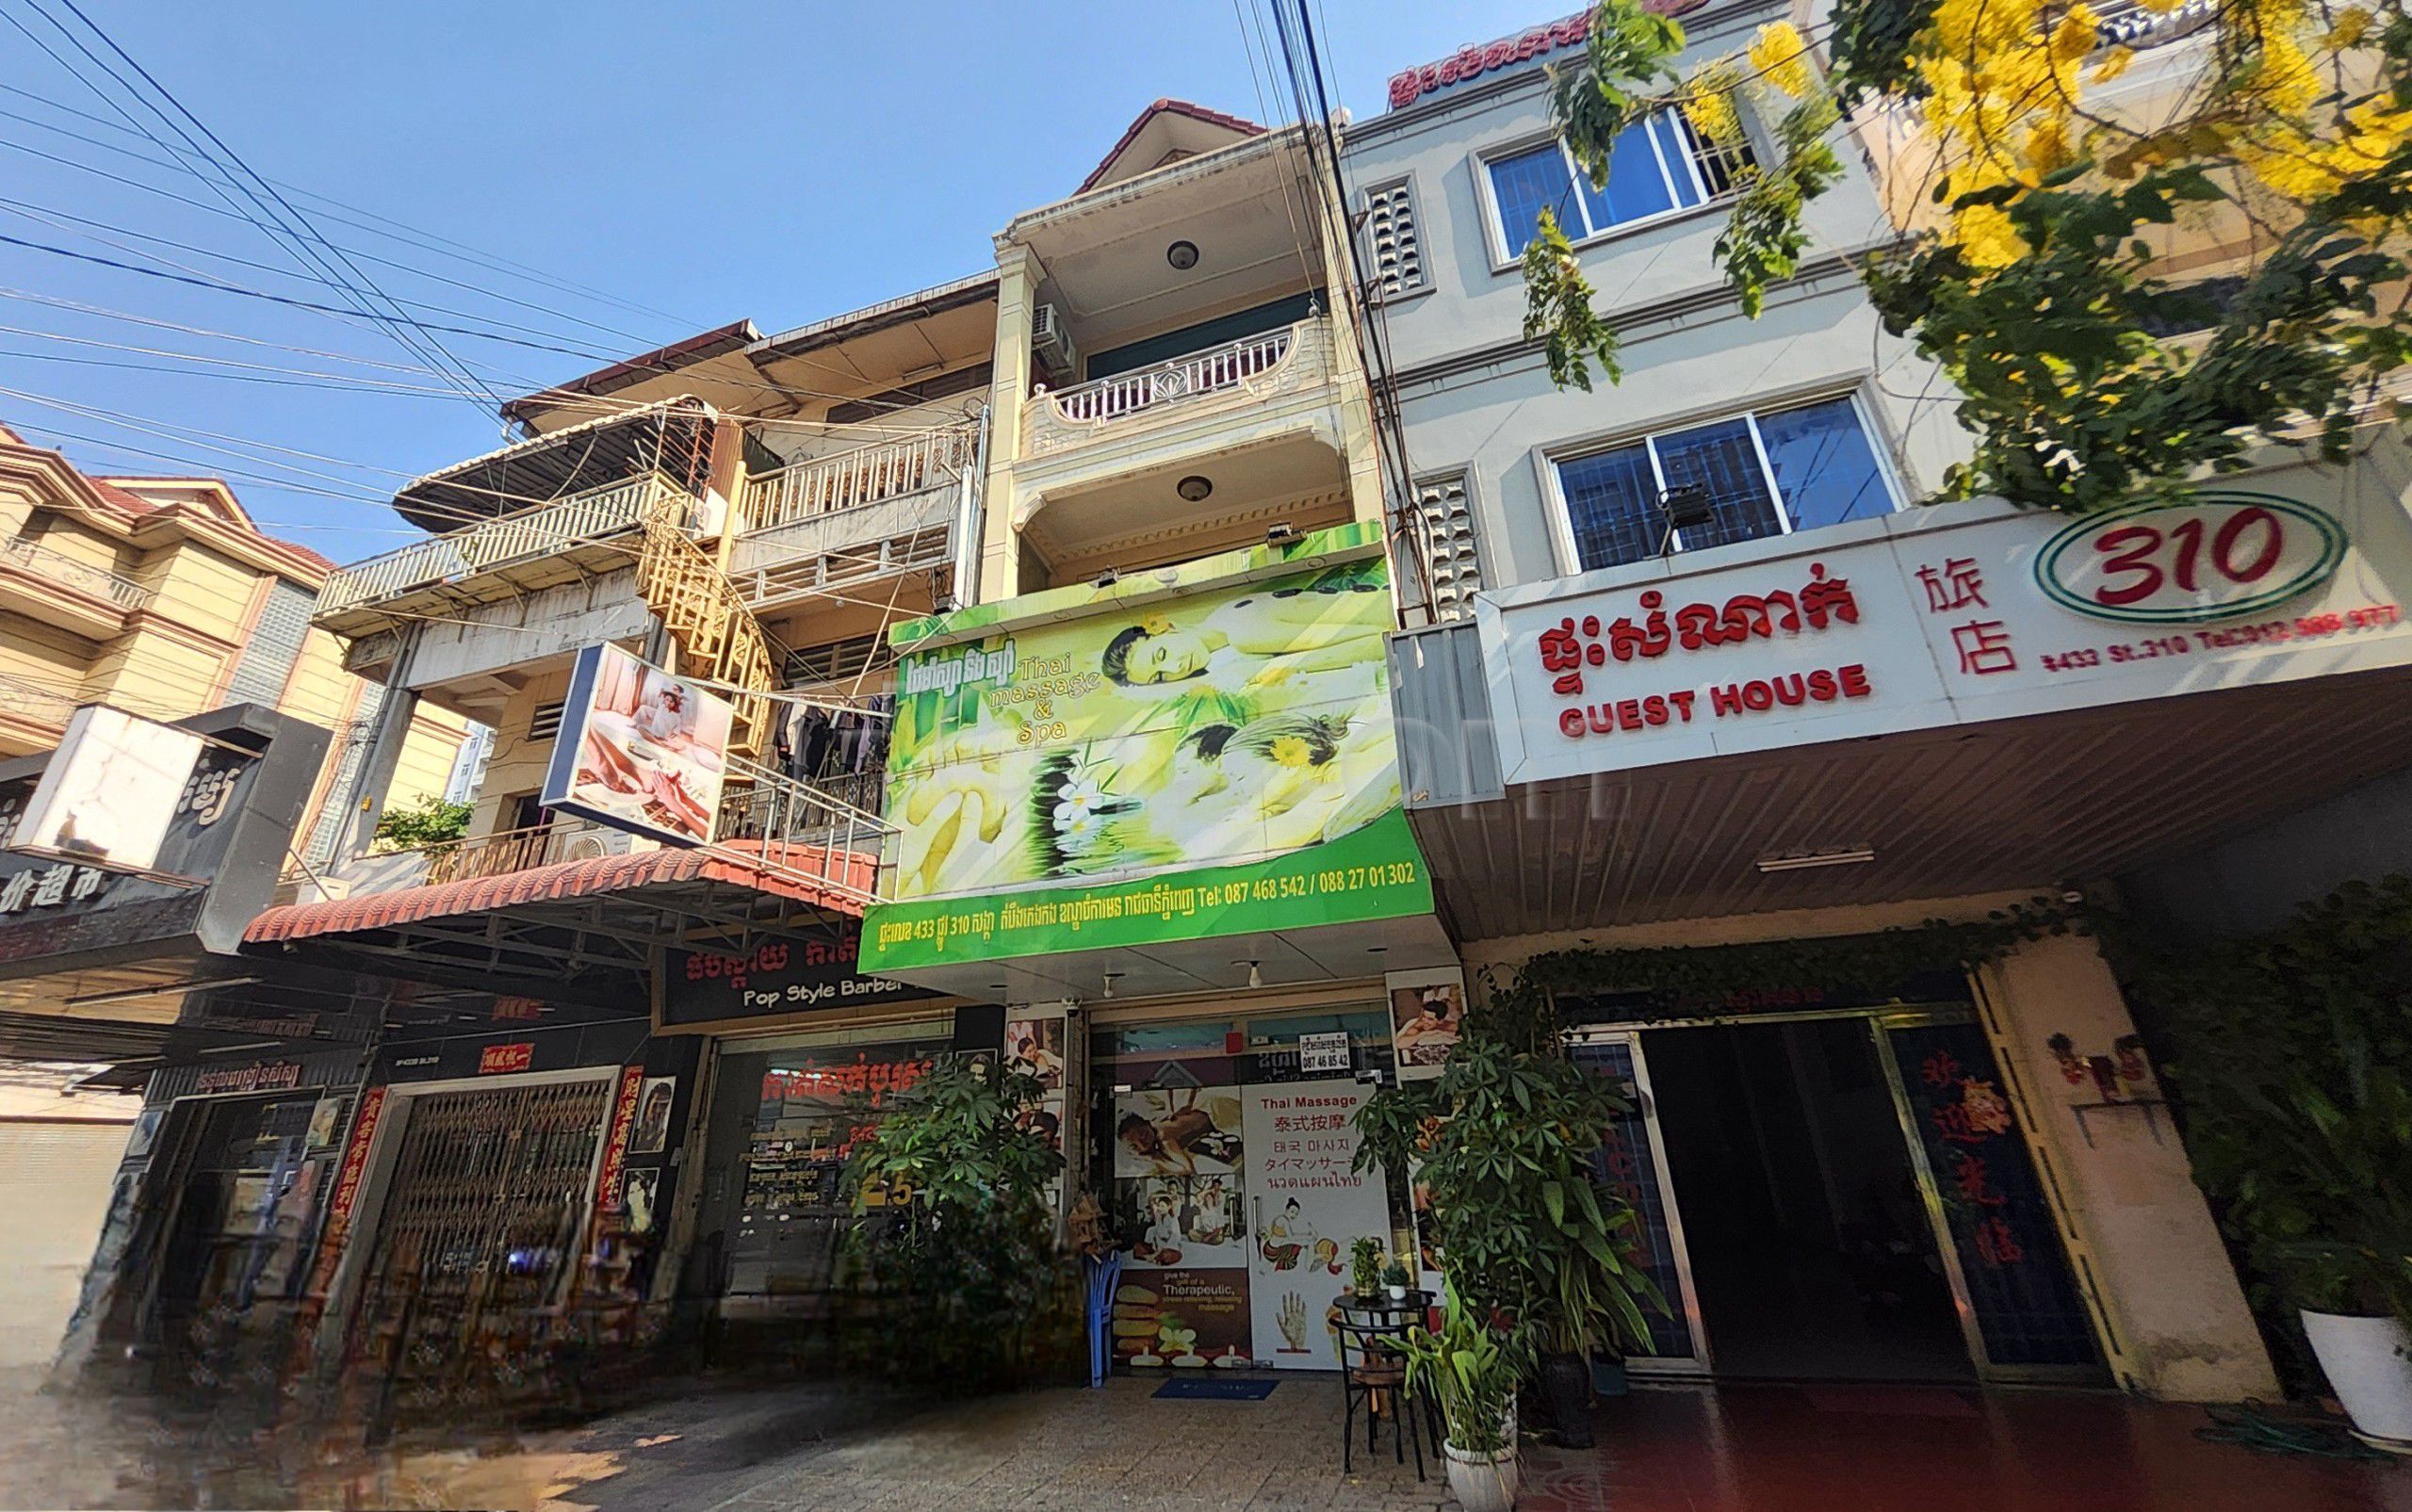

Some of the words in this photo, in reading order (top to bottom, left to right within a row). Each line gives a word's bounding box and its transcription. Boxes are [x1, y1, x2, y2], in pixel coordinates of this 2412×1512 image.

[2093, 506, 2287, 608] 310
[1539, 561, 1860, 695] ផ្ទះសំណាក់
[1915, 556, 2017, 676] 旅店
[1019, 652, 1071, 680] Thai
[990, 672, 1101, 707] massage
[1558, 690, 1696, 739] GUEST
[1709, 663, 1872, 717] HOUSE
[1034, 700, 1054, 721] &
[1018, 721, 1067, 748] Spa
[914, 919, 934, 939] 433
[950, 916, 970, 935] 310
[1198, 886, 1222, 908] Tel:
[1225, 883, 1248, 905] 087
[1252, 880, 1277, 902] 468
[1280, 876, 1306, 899] 542
[1319, 871, 1345, 894] 088
[1348, 869, 1366, 891] 27
[743, 990, 781, 1009] Pop
[786, 982, 835, 1005] Style
[1302, 1056, 1316, 1069] 087
[1261, 1098, 1291, 1110] Thai
[1295, 1096, 1358, 1109] Massage
[1274, 1114, 1347, 1132] 泰式按摩
[1274, 1140, 1301, 1154] 태국
[1308, 1138, 1350, 1153] 마사지
[1266, 1171, 1362, 1190] นวดแผนไทย
